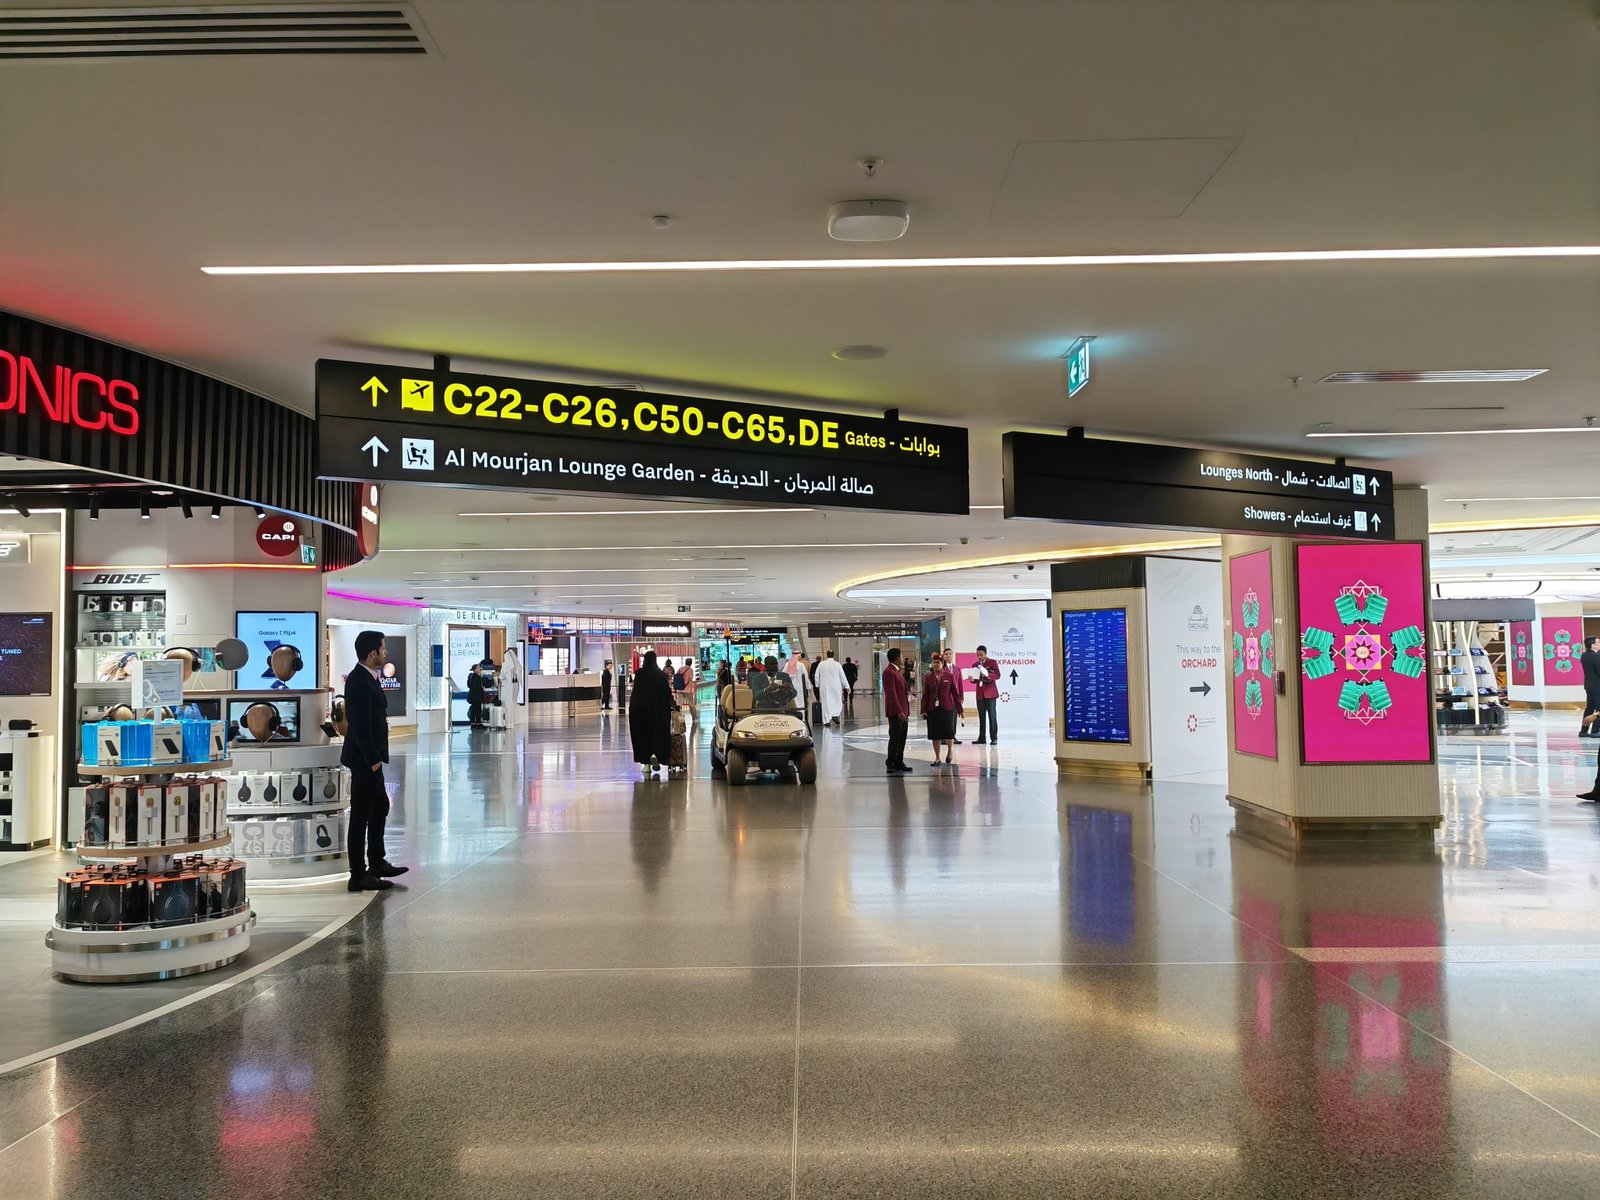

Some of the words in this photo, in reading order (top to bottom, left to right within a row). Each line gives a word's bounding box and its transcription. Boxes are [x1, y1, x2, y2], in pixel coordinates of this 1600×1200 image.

[845, 431, 886, 448] Gates
[899, 436, 940, 457] بوابات
[445, 448, 465, 467] Al
[472, 452, 553, 475] Mourjan
[559, 458, 627, 481] Lounge
[632, 463, 695, 482] Garden
[711, 468, 769, 489] الحديقة
[1201, 463, 1243, 481] Lounges
[1246, 468, 1273, 482] North
[1281, 470, 1308, 487] شمال
[784, 473, 836, 494] المرجان
[840, 477, 874, 495] صالة
[1244, 506, 1286, 522] Showers
[1294, 509, 1331, 528] استحمام
[1332, 515, 1352, 529] غرف
[262, 533, 295, 541] CAPI
[82, 573, 161, 585] BOSE
[1175, 644, 1190, 654] This
[1191, 646, 1203, 655] way
[1203, 645, 1211, 653] to
[1211, 644, 1222, 653] the
[1181, 658, 1217, 668] ORCHARD
